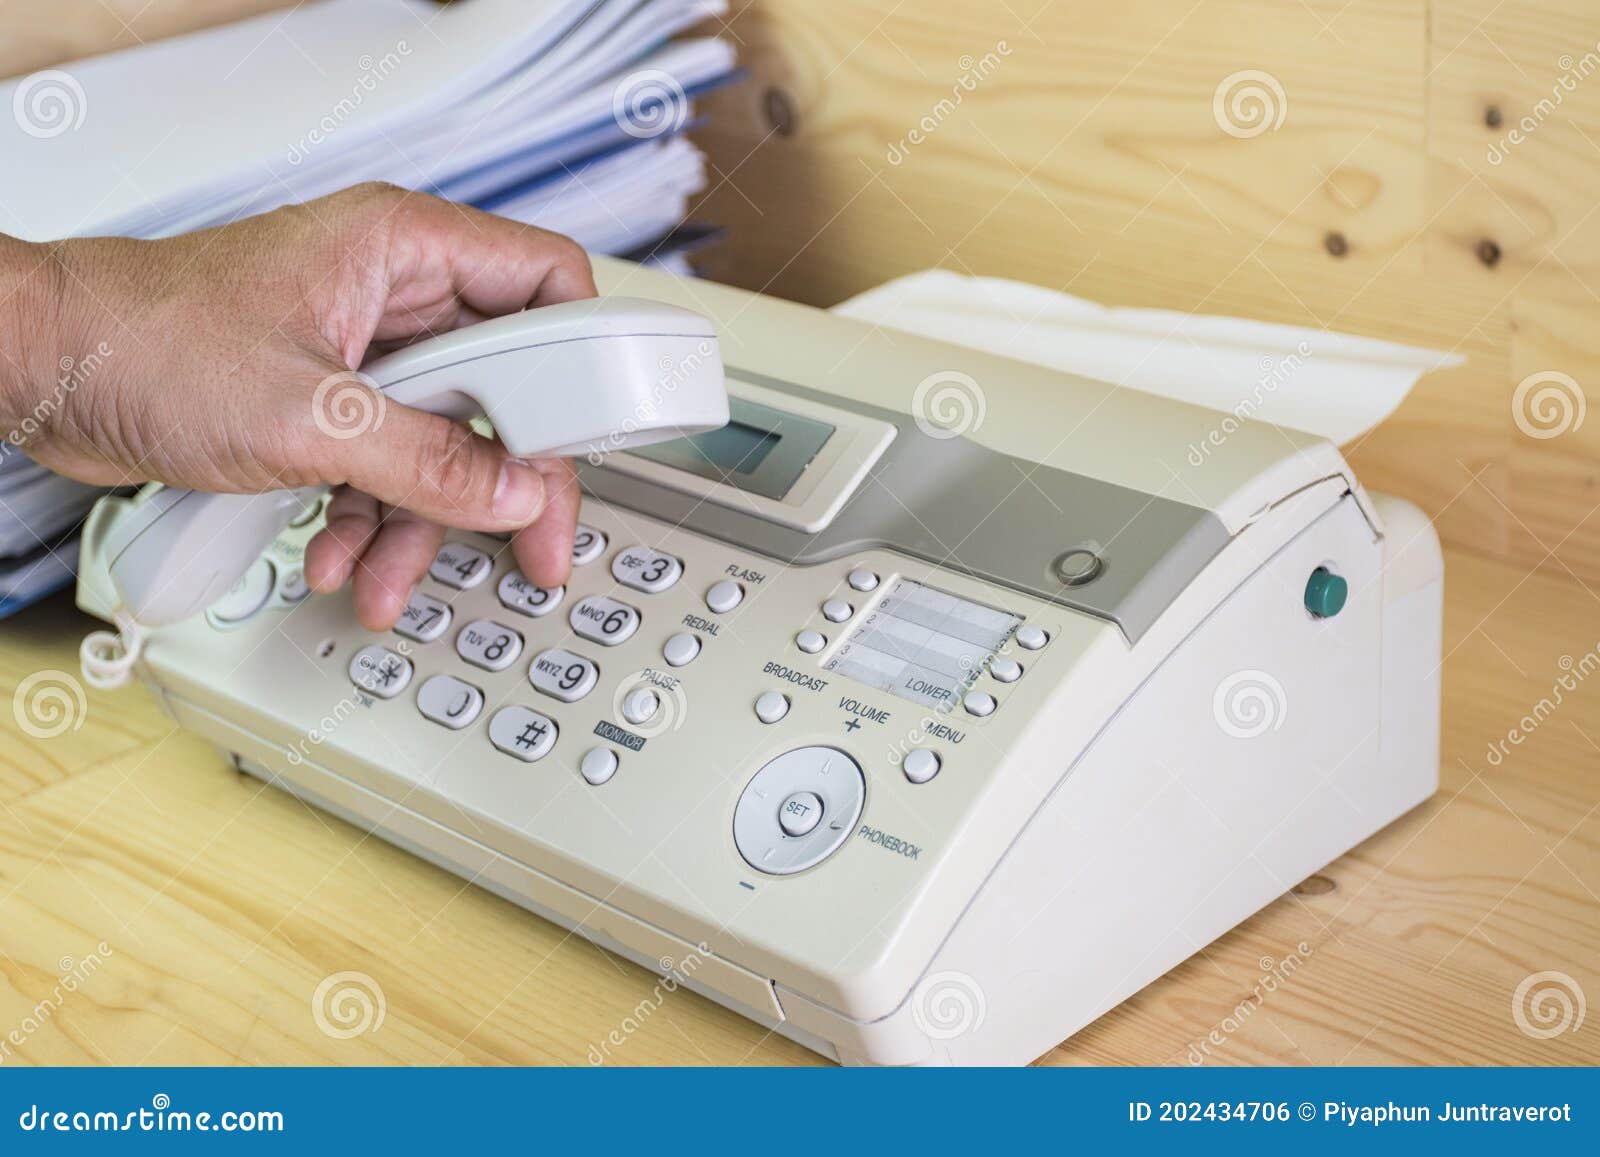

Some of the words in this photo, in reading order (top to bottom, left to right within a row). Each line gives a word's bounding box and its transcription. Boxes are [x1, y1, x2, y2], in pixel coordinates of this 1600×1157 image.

[456, 558, 480, 579] 4
[641, 558, 669, 582] 3
[725, 564, 766, 584] FLASH
[416, 606, 443, 631] 7
[578, 604, 605, 622] MNO
[601, 609, 629, 634] 6
[682, 614, 720, 636] REDIAL
[466, 630, 488, 646] TUV
[484, 634, 510, 660] 8
[536, 659, 562, 677] WXYZ
[559, 664, 585, 690] 9
[641, 669, 681, 692] PAUSE
[763, 662, 828, 692] BROADCAST
[905, 678, 952, 701] LOWER
[839, 697, 890, 724] VOLUME
[516, 721, 546, 749] #
[594, 721, 646, 751] MONITOR
[926, 722, 966, 744] MENU
[786, 802, 810, 817] SET
[858, 825, 922, 860] PHONEBOOK
